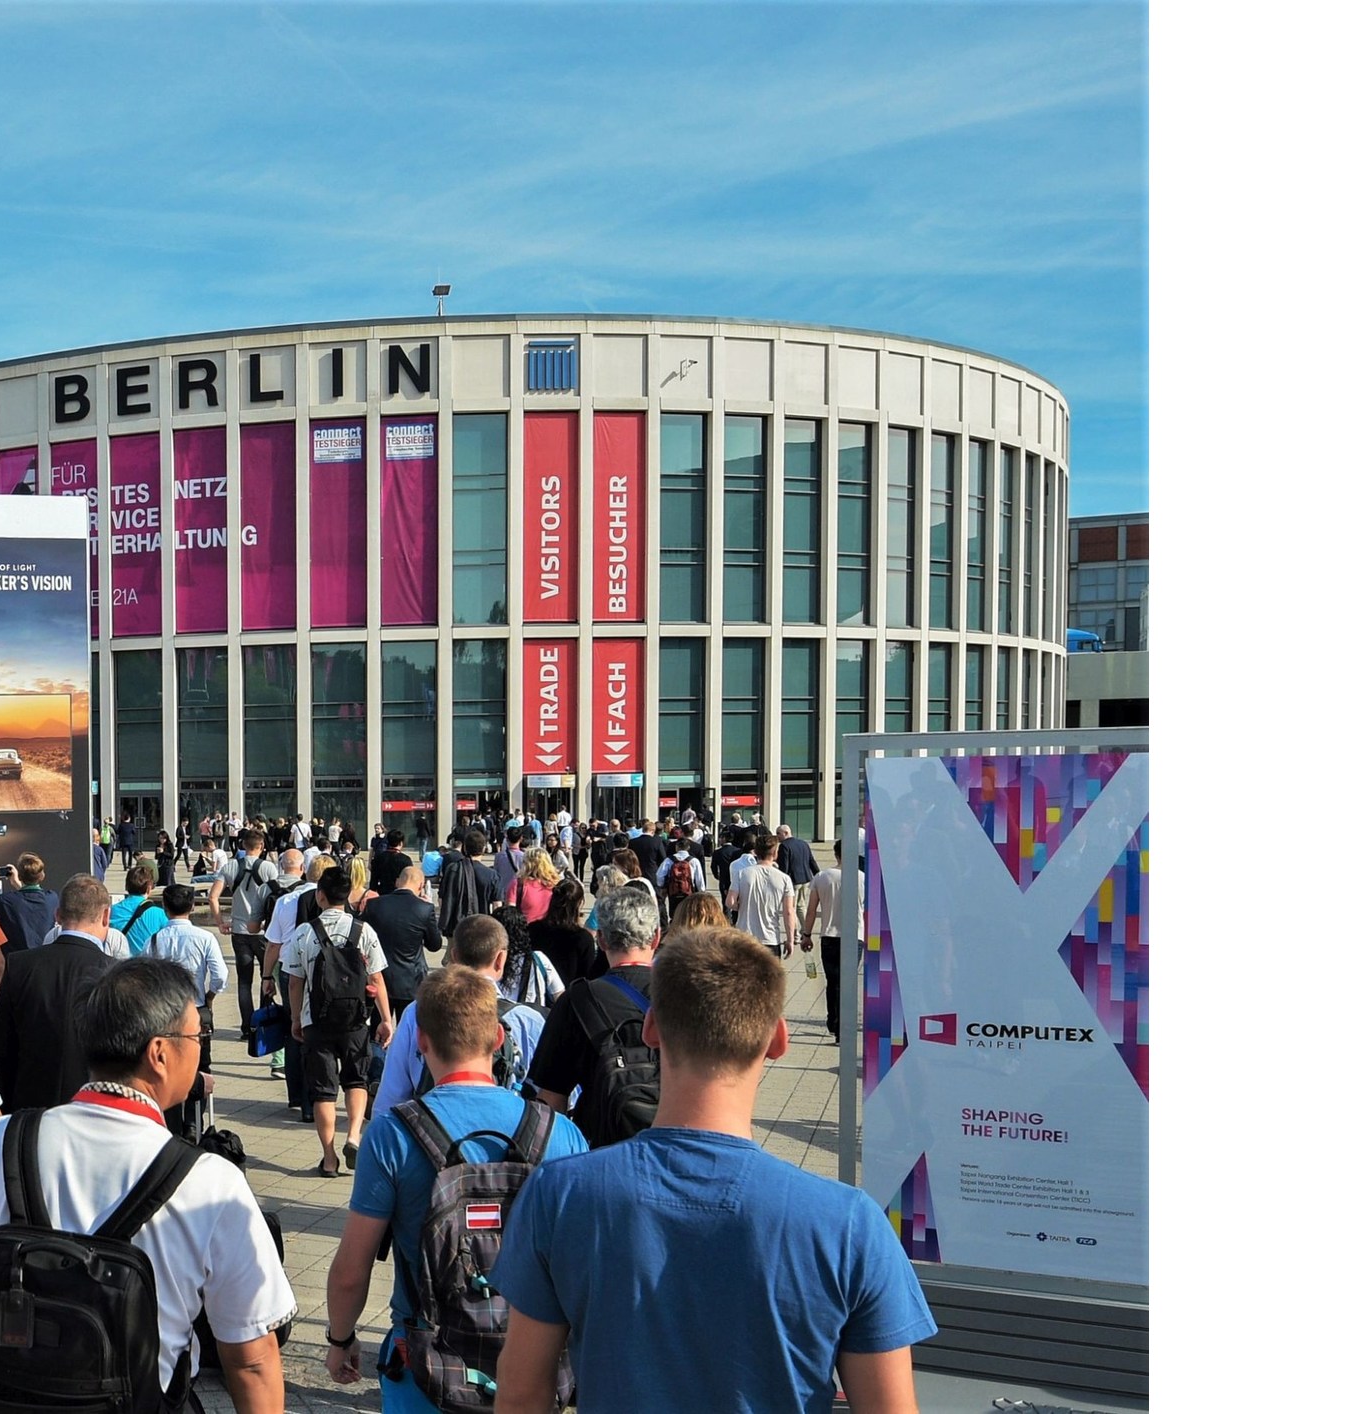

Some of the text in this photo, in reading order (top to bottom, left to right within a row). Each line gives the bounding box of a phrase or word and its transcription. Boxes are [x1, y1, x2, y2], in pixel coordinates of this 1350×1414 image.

[54, 343, 430, 423] BERLIN
[314, 426, 362, 439] connect
[386, 423, 434, 436] connect
[314, 438, 361, 448] TESTSIEGER
[386, 435, 434, 445] TESTSIEGER
[51, 461, 86, 486] FÜR
[175, 477, 227, 500] NETZ
[13, 564, 36, 572] LIGHT
[32, 575, 72, 591] VISION
[113, 588, 139, 606] 21A
[540, 475, 561, 736] TRADE VISITORS
[607, 475, 628, 736] FACH BESUCHER
[966, 1022, 1094, 1043] COMPUTEX
[966, 1039, 1022, 1050] TAIPEI
[961, 1107, 1044, 1126] SHAPING
[961, 1123, 1069, 1144] THE FUTURE!
